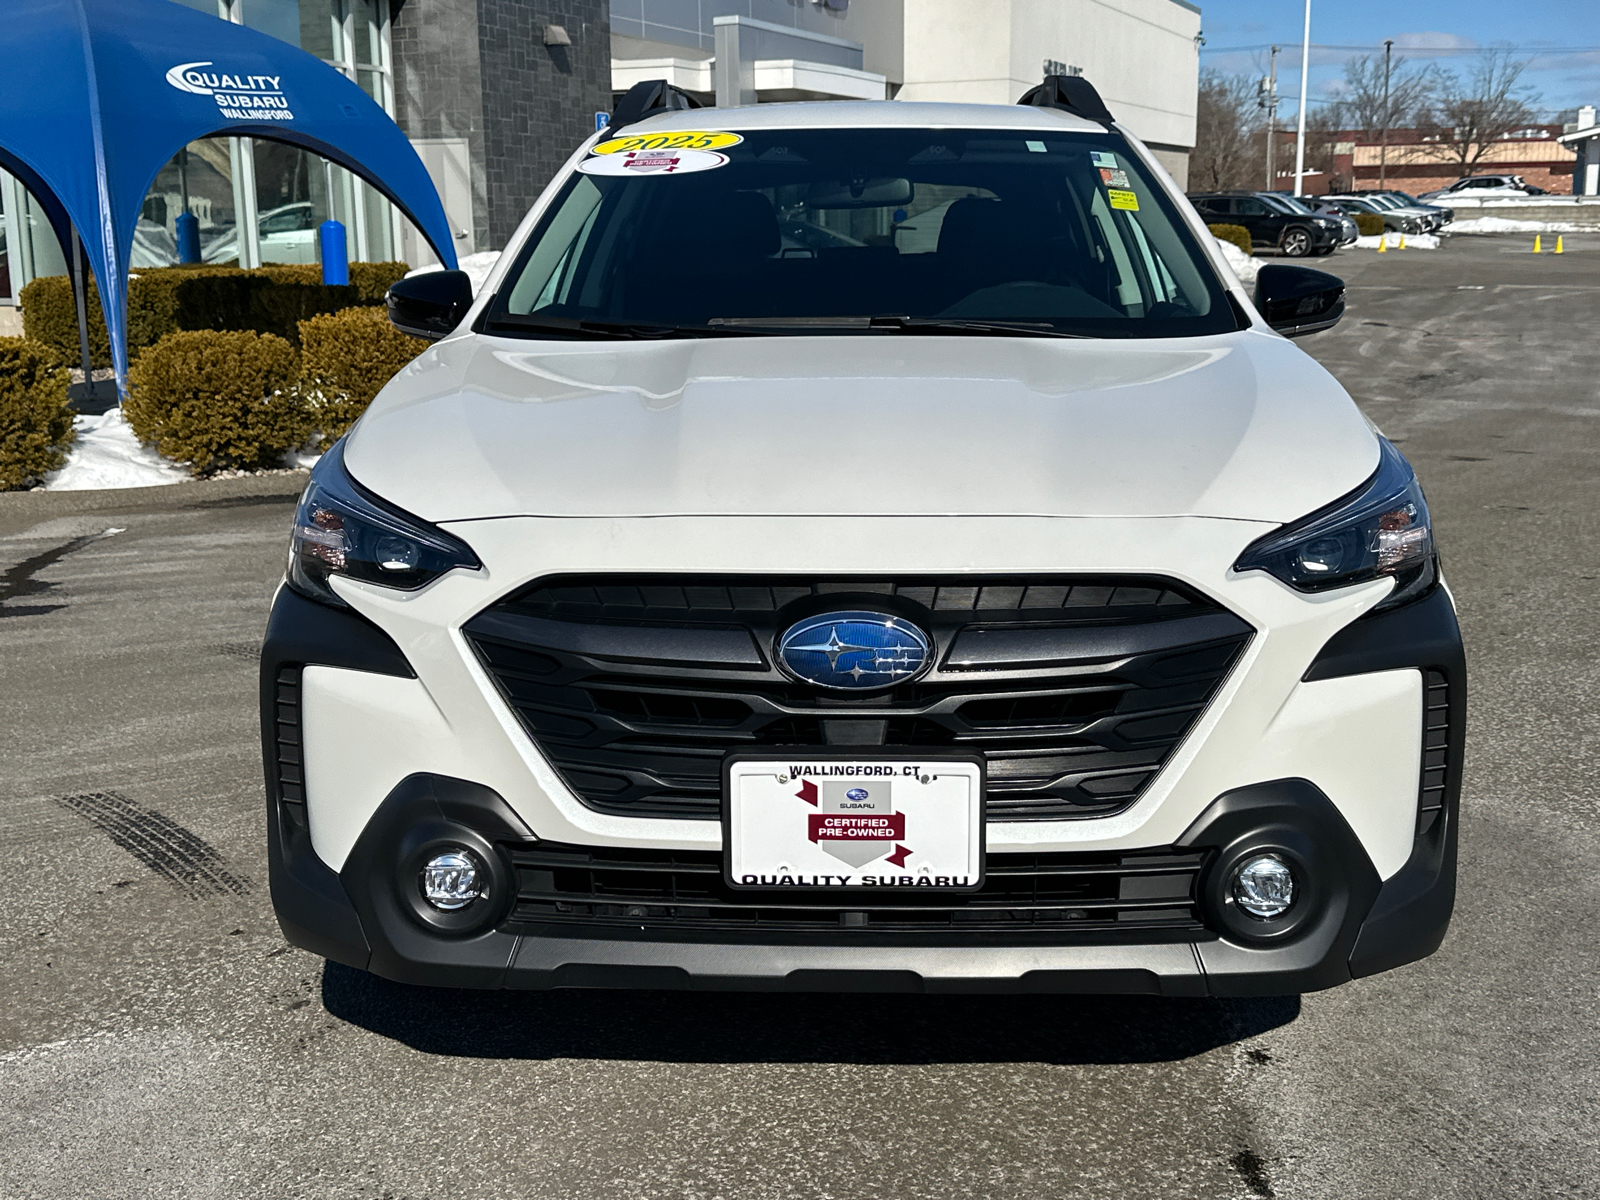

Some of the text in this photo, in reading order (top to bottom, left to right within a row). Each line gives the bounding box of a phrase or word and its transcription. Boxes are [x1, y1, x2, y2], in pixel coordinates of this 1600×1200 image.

[186, 71, 280, 89] QUALITY
[214, 94, 289, 108] SUBARU
[219, 108, 294, 120] WALLINGFORD
[613, 134, 722, 153] 2025
[789, 765, 921, 777] WALLINGFORD, CT
[824, 818, 889, 828] CERTIFIED
[818, 827, 895, 837] PRE-OWNED
[741, 874, 969, 887] QUALITY SUBARU
